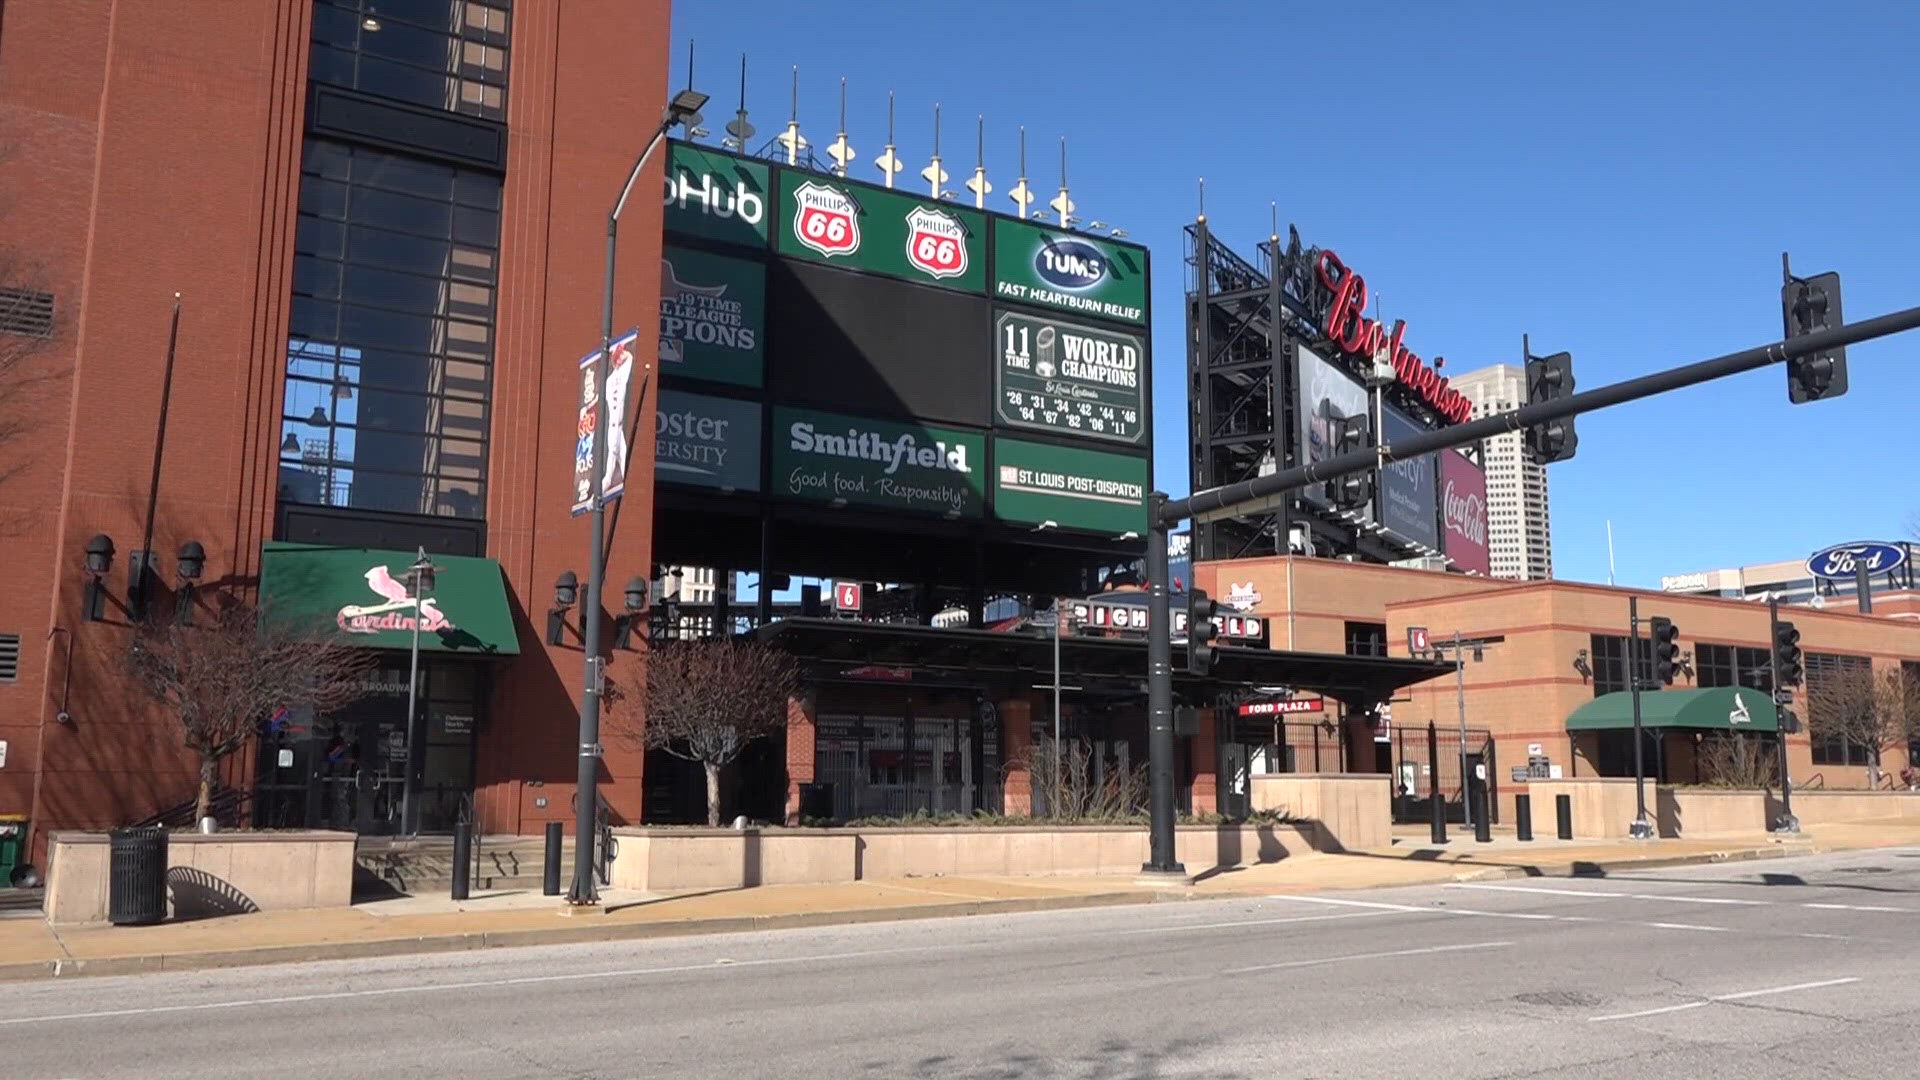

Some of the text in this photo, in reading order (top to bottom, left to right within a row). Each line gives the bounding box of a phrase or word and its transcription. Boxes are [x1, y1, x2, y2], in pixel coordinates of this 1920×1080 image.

[806, 193, 849, 213] PHILLIPS
[806, 212, 847, 242] 66
[917, 217, 958, 236] PHILLIPS
[917, 236, 955, 264] 66
[1043, 250, 1100, 279] TUMS
[680, 293, 741, 314] 19 TIME
[998, 281, 1141, 320] FAST HEARTBURN RELIEF
[675, 304, 741, 327] LEAGUE
[660, 316, 755, 350] PIONS
[1005, 324, 1030, 357] 11
[1319, 250, 1474, 423] Budweiser
[1005, 355, 1030, 369] TIME
[1062, 334, 1136, 371] WORLD
[1061, 359, 1136, 388] CHAMPIONS
[790, 466, 828, 494] Good
[834, 472, 869, 494] food.
[1019, 469, 1142, 498] ST. LOUIS POST-DISPATCH
[1824, 547, 1883, 576] Fod
[1662, 574, 1708, 590] Peabody
[844, 588, 854, 605] 6
[337, 605, 452, 634] Cardinals
[1176, 611, 1260, 636] FELD
[1417, 632, 1425, 648] 6
[1248, 700, 1311, 714] FORD PLAZA
